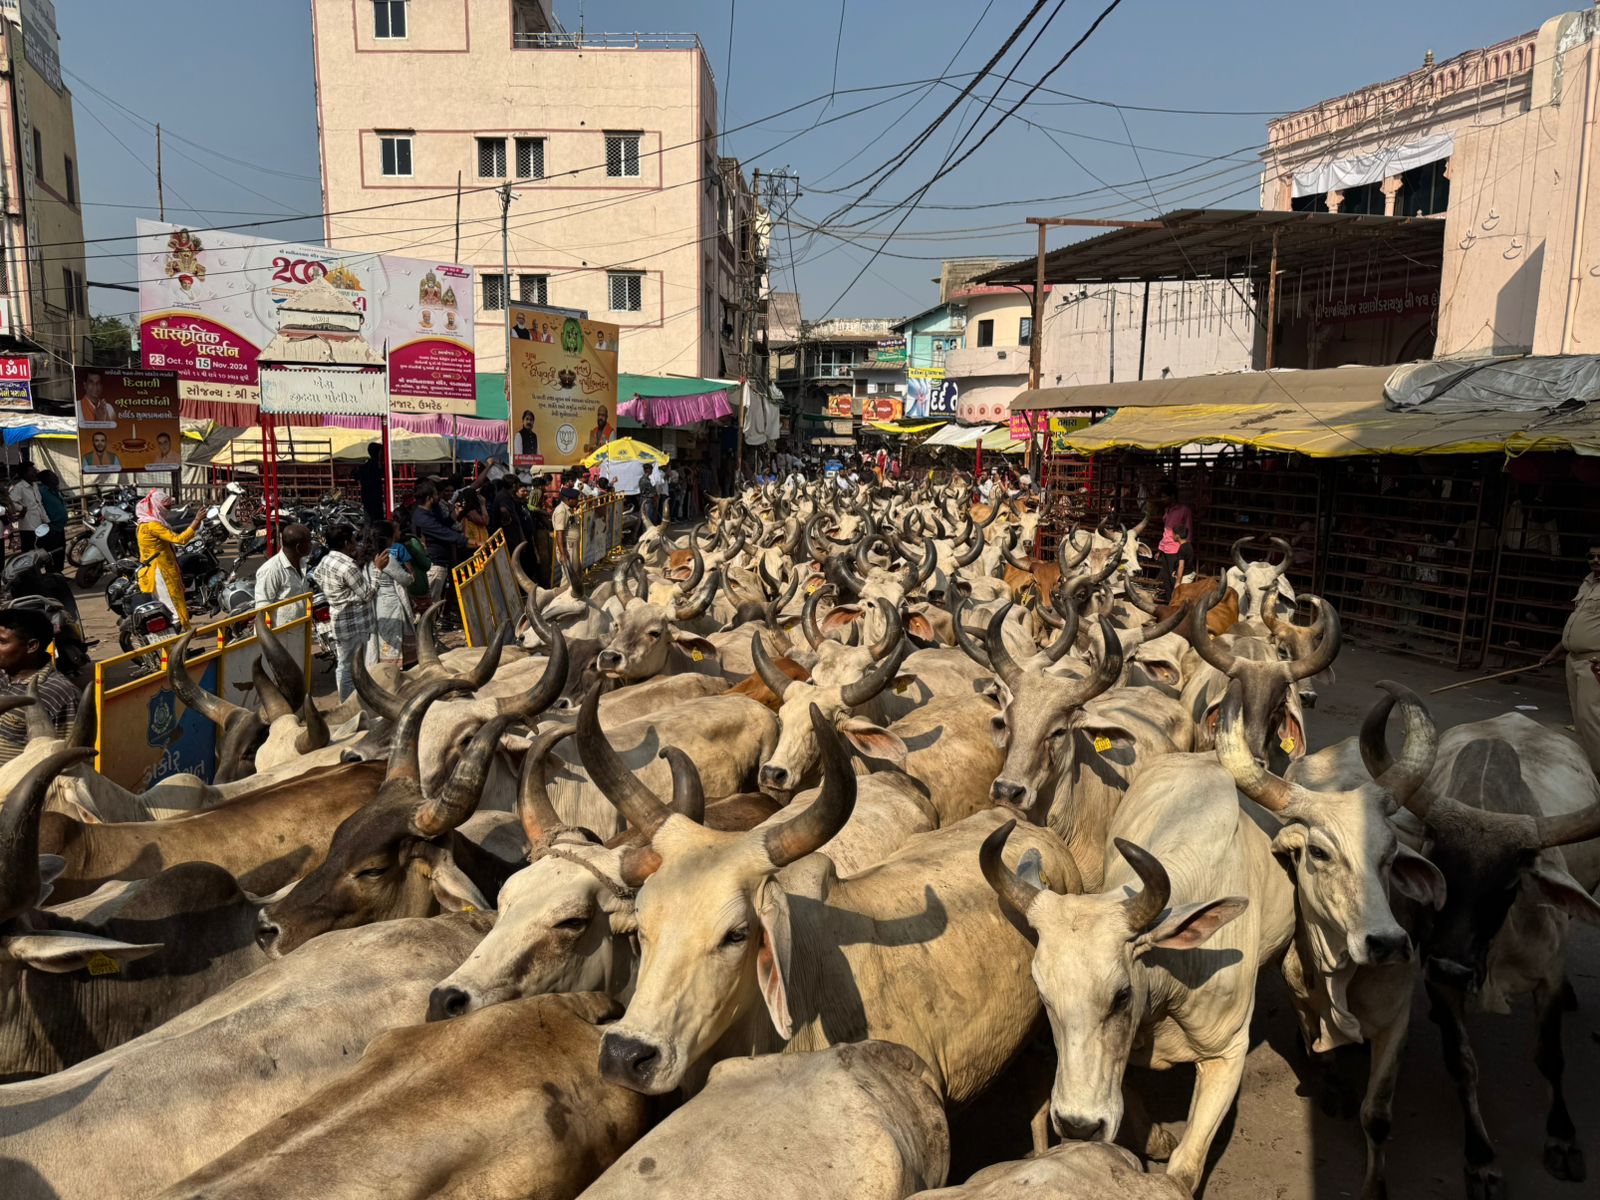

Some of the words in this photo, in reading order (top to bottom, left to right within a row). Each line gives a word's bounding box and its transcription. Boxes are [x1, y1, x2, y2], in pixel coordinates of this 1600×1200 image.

[196, 340, 240, 358] प्रदर्शन
[150, 355, 165, 365] 23
[167, 357, 183, 365] Oct.
[185, 358, 194, 366] to
[198, 358, 210, 368] 15
[212, 362, 248, 371] Nov.2024
[187, 385, 223, 398] સૌજન્ય
[234, 388, 247, 400] શ્રી
[418, 400, 442, 410] ઉમરેઠ
